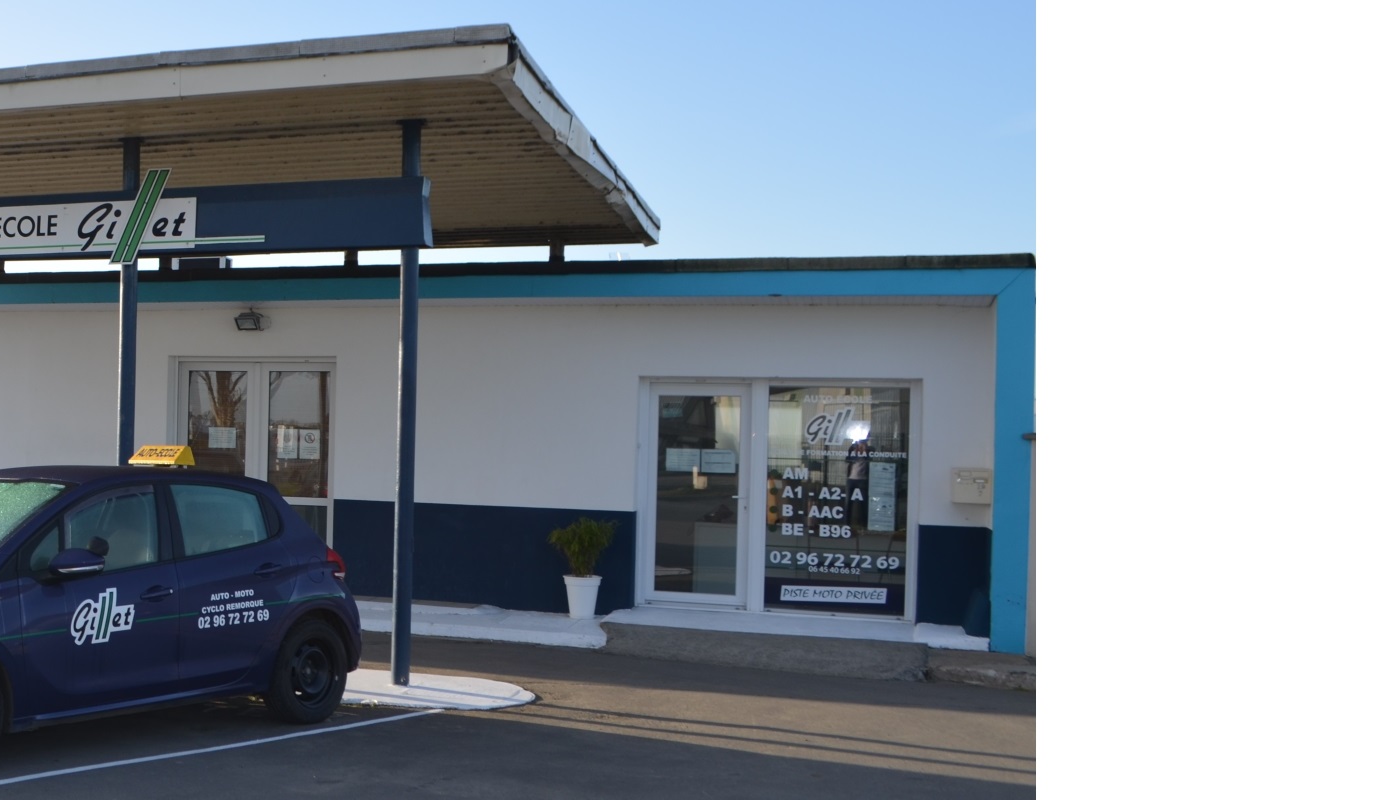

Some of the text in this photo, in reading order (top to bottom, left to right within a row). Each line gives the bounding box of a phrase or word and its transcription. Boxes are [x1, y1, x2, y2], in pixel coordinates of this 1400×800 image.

[77, 168, 186, 265] Gillet
[806, 449, 849, 457] FORMATION
[869, 451, 907, 459] CONDUITE
[782, 467, 809, 480] AM
[782, 486, 803, 499] A1
[851, 488, 863, 501] A
[782, 504, 793, 517] B
[808, 505, 844, 519] AAC
[782, 523, 804, 536] BE
[819, 524, 851, 538] B96
[770, 551, 900, 570] 02 96 72 72 69
[210, 592, 230, 601] AUTO
[234, 589, 255, 598] MOTO
[782, 587, 811, 598] PISTE
[812, 588, 843, 599] MOTO
[201, 599, 264, 614] CYCLO REMORQUE
[72, 589, 134, 644] Gillet
[198, 609, 270, 629] 02 96 72 72 69
